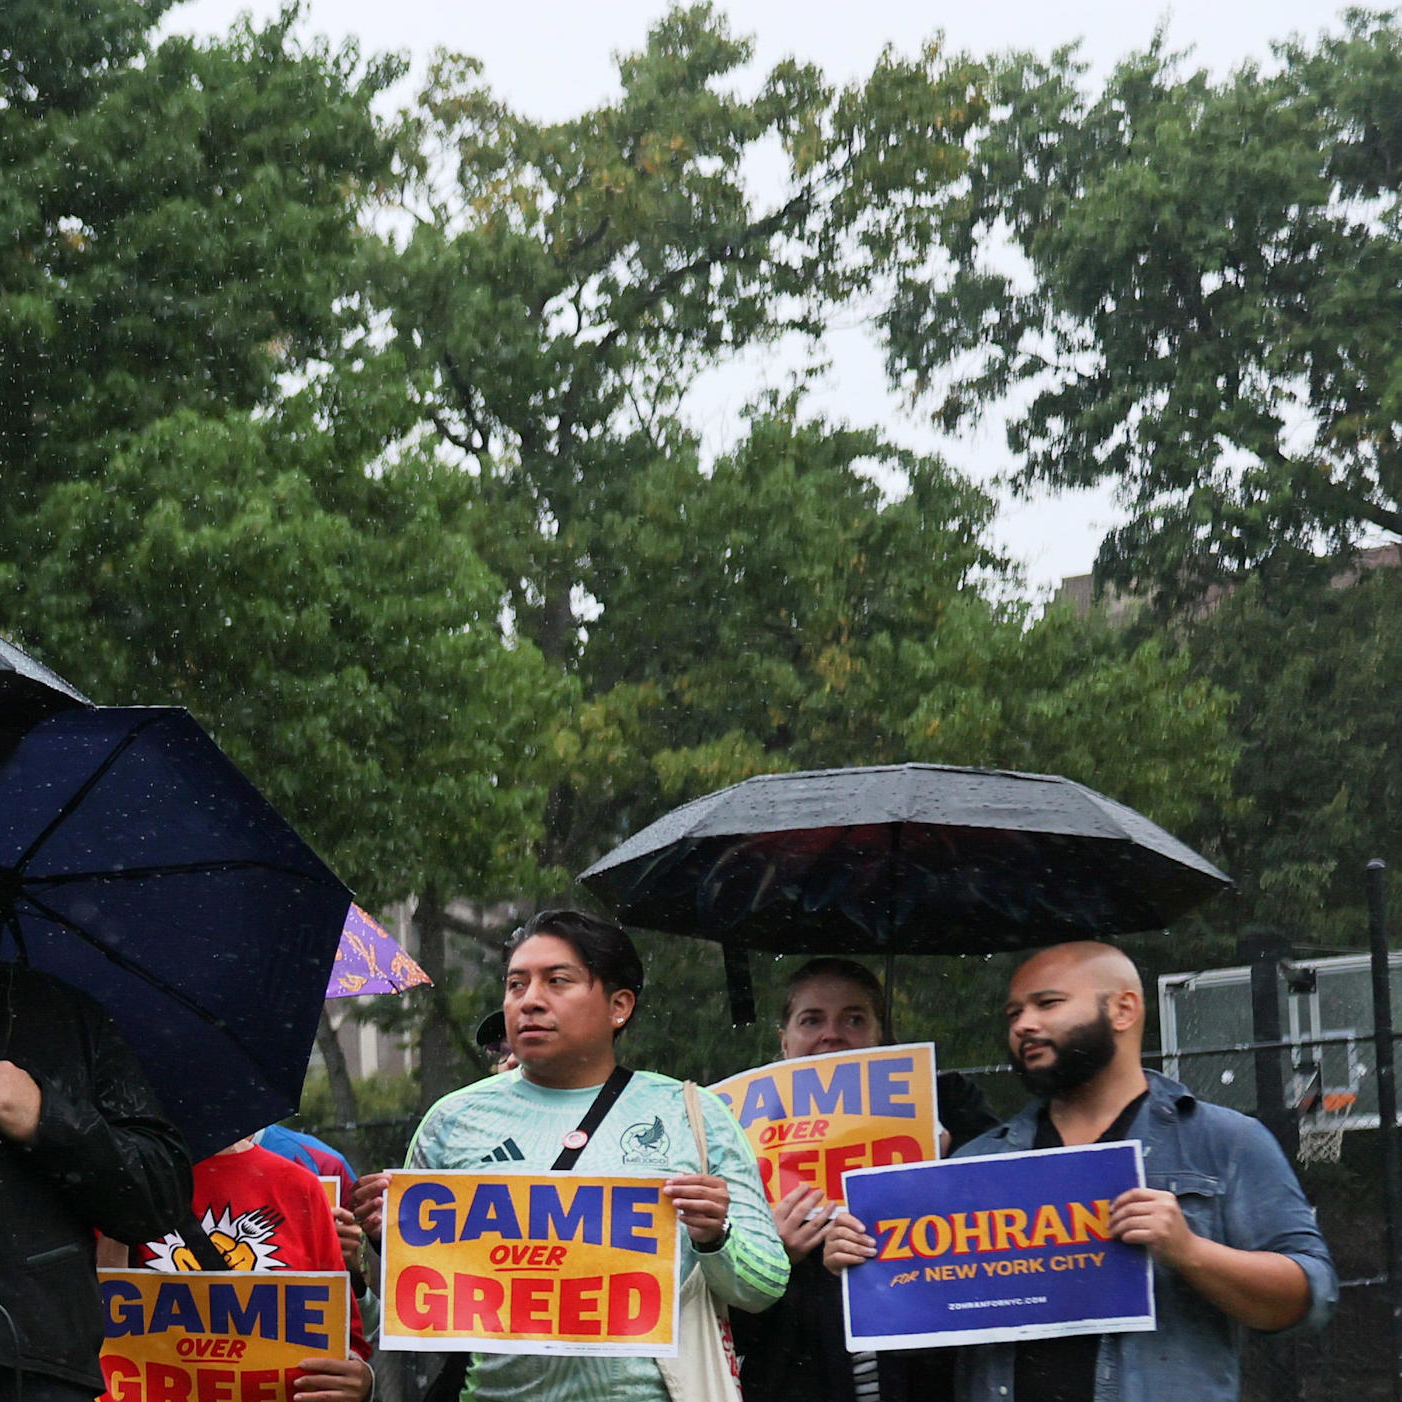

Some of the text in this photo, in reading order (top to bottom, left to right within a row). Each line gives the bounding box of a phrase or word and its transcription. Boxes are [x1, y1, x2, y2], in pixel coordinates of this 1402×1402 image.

[759, 1119, 829, 1144] OVER
[398, 1182, 660, 1255] GAME
[876, 1200, 1113, 1262] ZOHRAN
[489, 1245, 567, 1266] OVER
[890, 1253, 1105, 1287] FOR NEW YORK CITY
[100, 1279, 329, 1350] GAME
[395, 1265, 662, 1336] GREED
[176, 1337, 247, 1358] OVER
